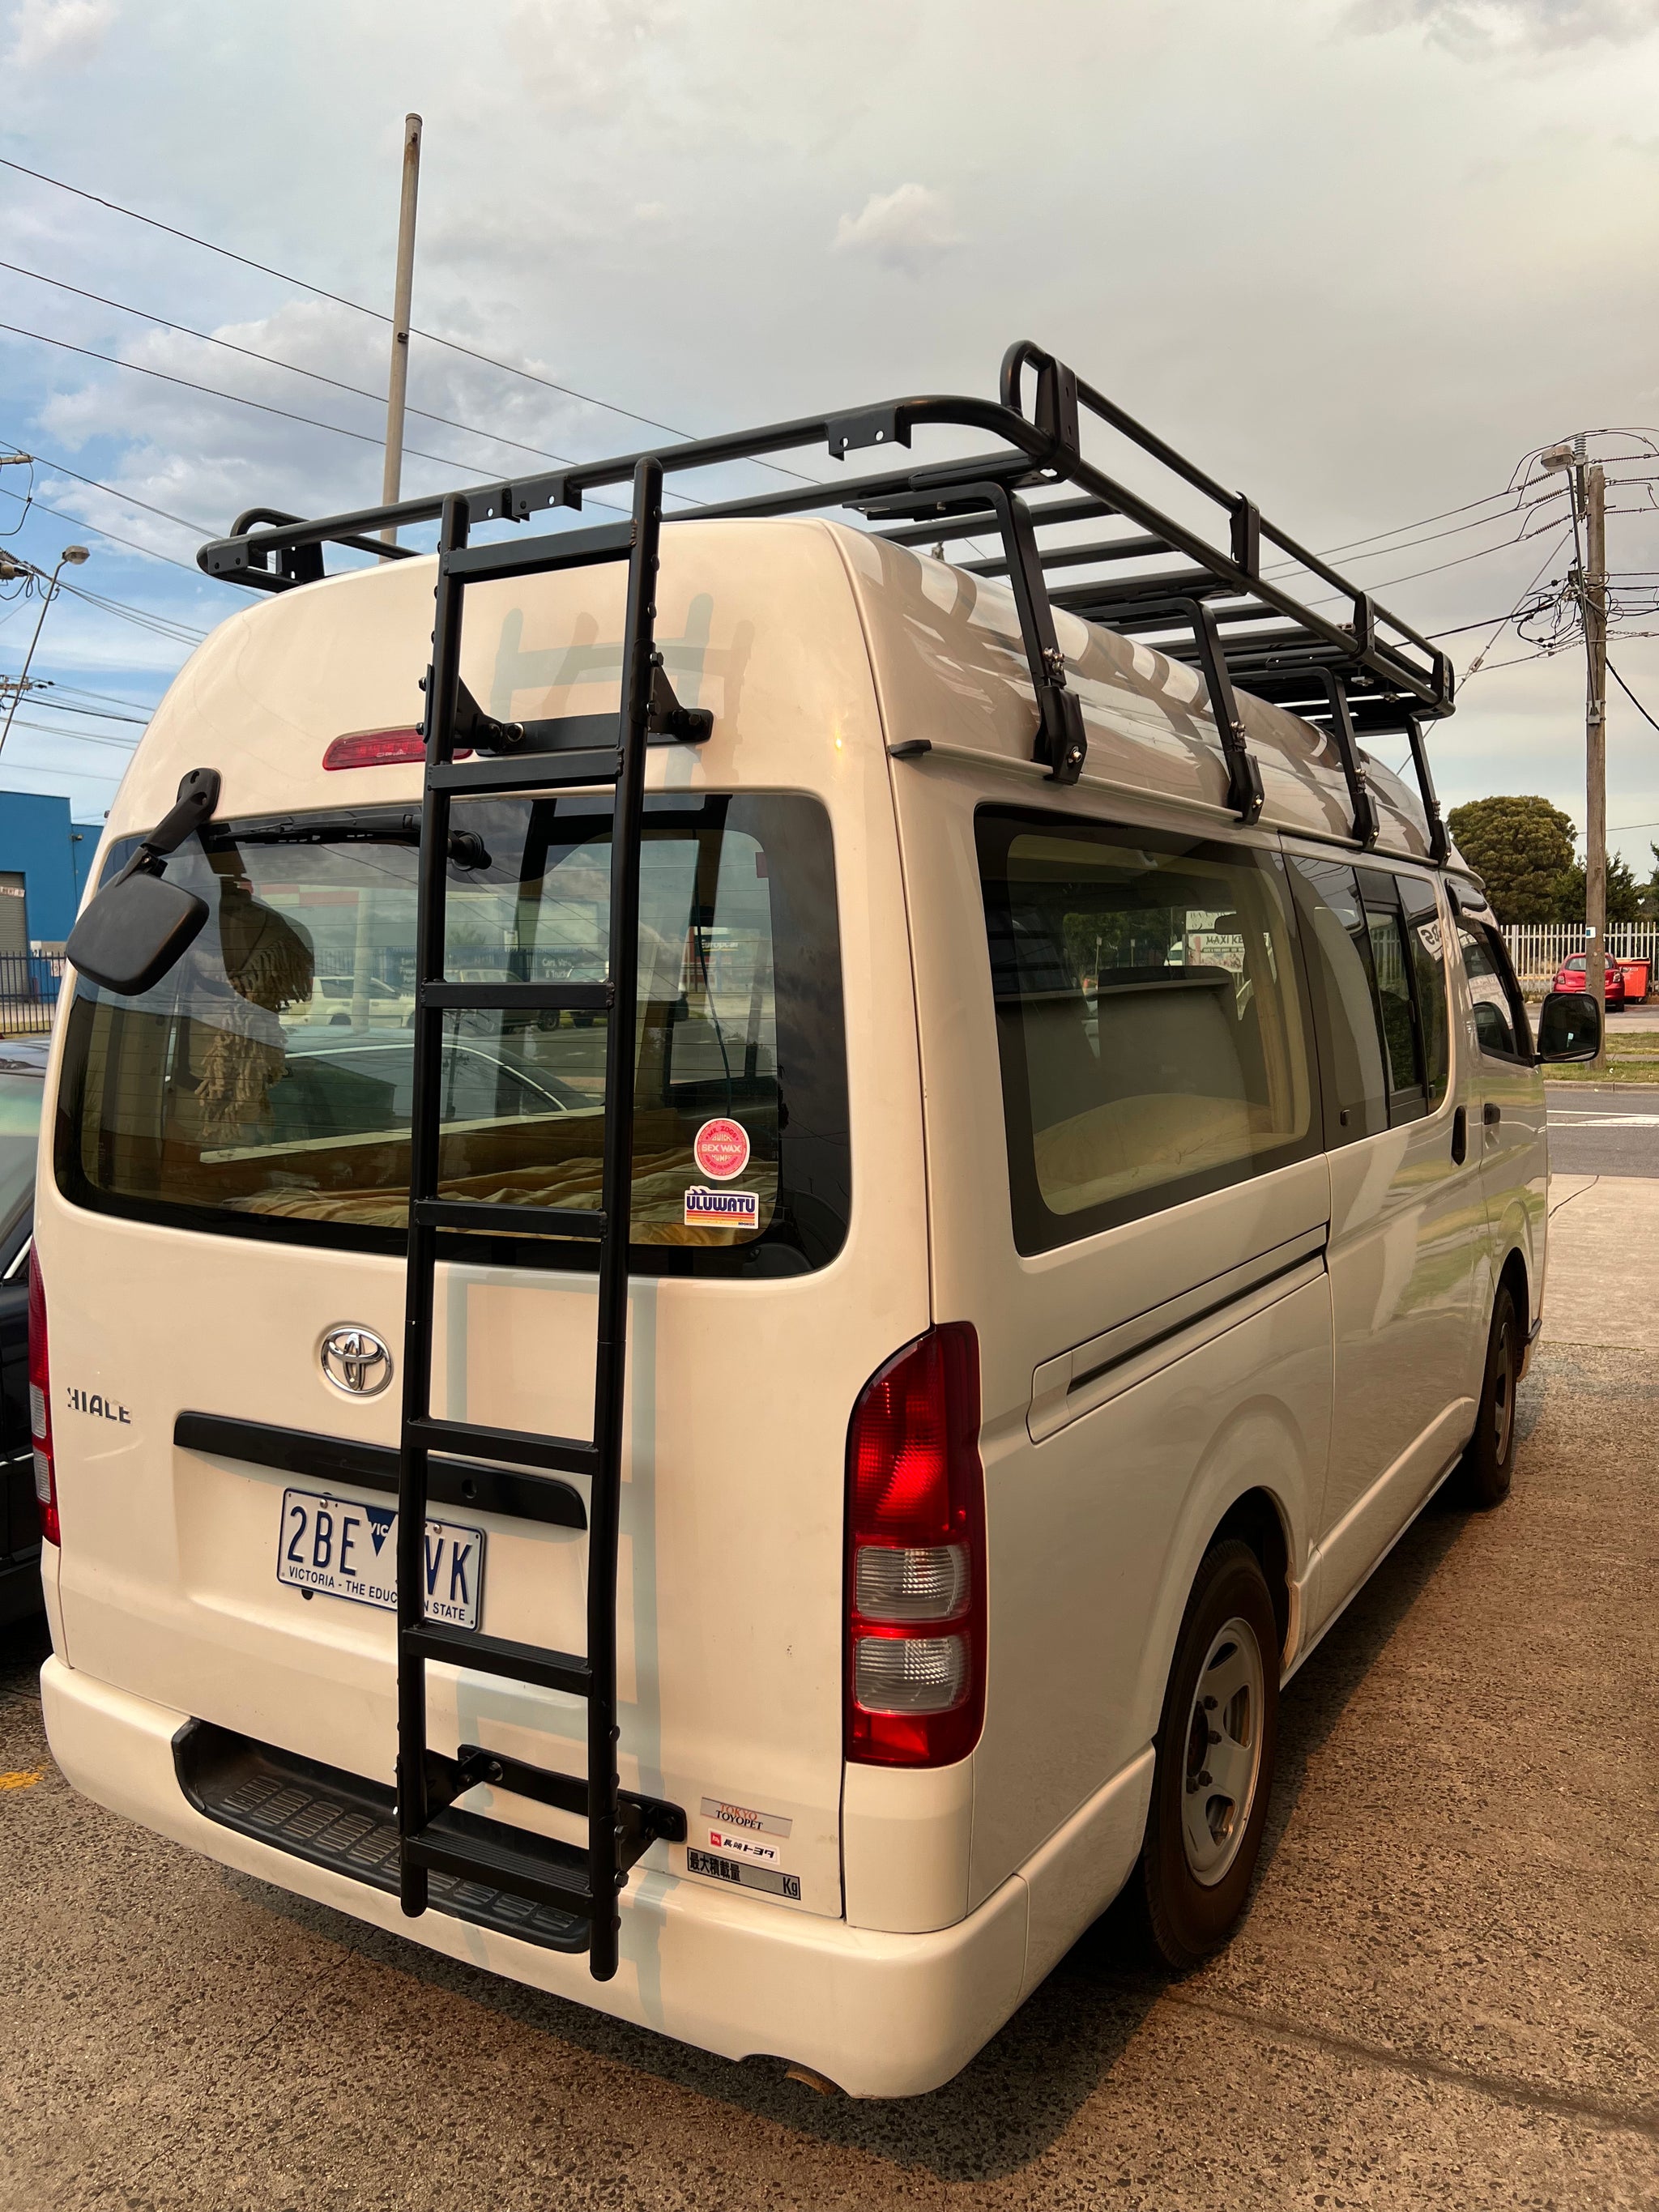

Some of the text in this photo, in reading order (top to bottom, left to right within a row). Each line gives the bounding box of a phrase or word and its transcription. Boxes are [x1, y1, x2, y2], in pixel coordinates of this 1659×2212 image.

[1231, 935, 1243, 944] KE
[702, 1144, 741, 1153] SEX WAX
[686, 1196, 756, 1213] ULUWATU
[370, 1522, 389, 1537] VIC
[287, 1506, 360, 1576] 2BE
[289, 1566, 335, 1588] VICTORIA
[346, 1580, 365, 1596] THE
[433, 1602, 466, 1621] STATE
[716, 1809, 764, 1831] TOYOPET
[720, 1803, 758, 1821] TOKYO
[690, 1852, 798, 1897] 最大積載量 Kg
